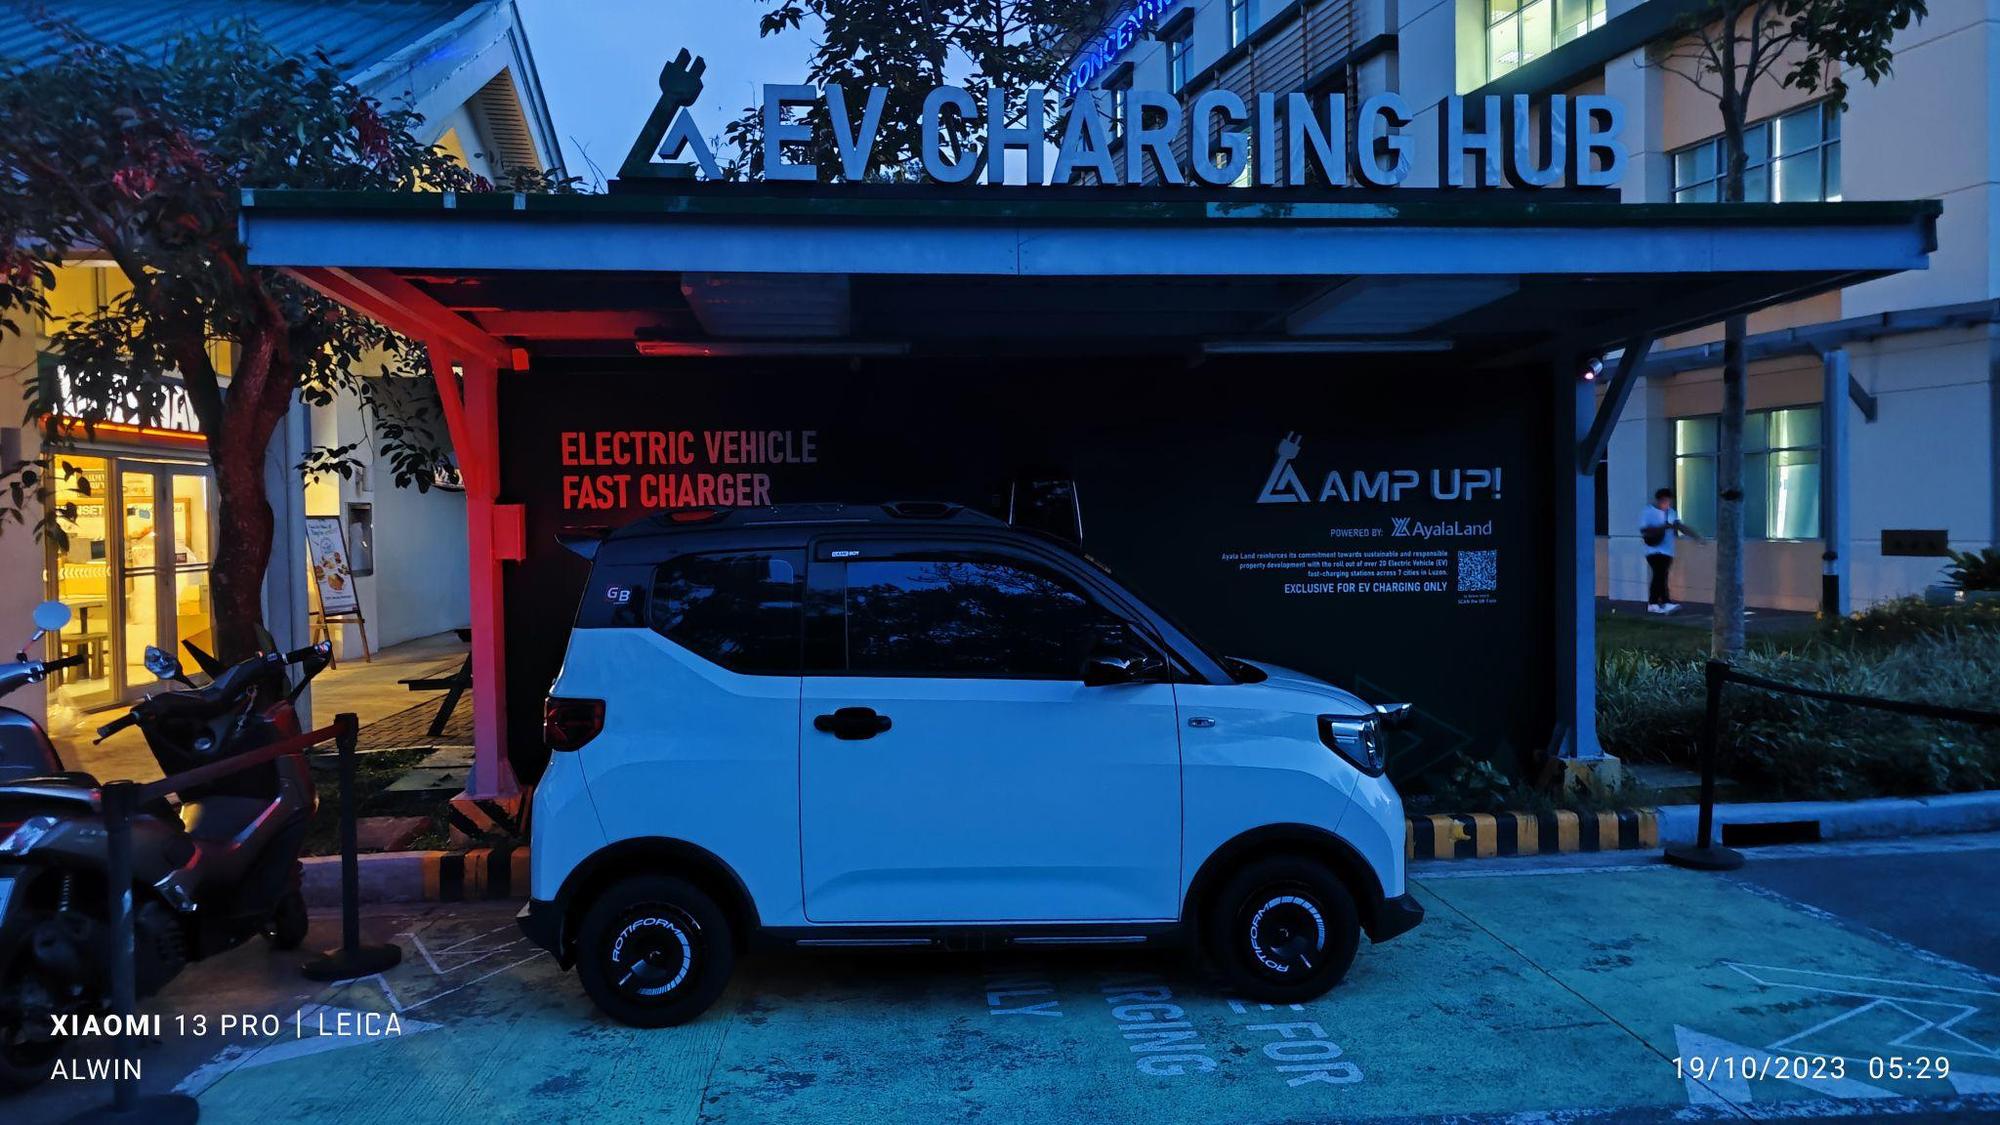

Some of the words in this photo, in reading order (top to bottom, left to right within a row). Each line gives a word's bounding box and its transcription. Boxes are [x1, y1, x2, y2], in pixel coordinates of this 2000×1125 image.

[763, 84, 888, 182] EV
[921, 85, 1414, 188] CHARGING
[1444, 93, 1629, 189] HUB
[562, 431, 695, 466] ELECTRIC
[704, 430, 818, 465] VEHICLE
[563, 474, 632, 510] FAST
[640, 473, 772, 508] CHARGER
[1318, 469, 1421, 503] AMP
[1431, 467, 1503, 502] UP!
[1330, 528, 1370, 538] POWERED
[1371, 528, 1384, 537] BY:
[1411, 520, 1493, 541] AyalaLand
[1239, 562, 1266, 571] property
[1266, 562, 1306, 570] development
[1333, 560, 1345, 568] roll
[1388, 559, 1412, 567] Electric
[1413, 559, 1435, 567] Vehicle
[1240, 552, 1256, 560] Land
[1337, 551, 1362, 559] towards
[1413, 550, 1448, 559] responsible
[1284, 583, 1335, 594] EXCLUSIVE
[1336, 583, 1356, 593] FOR
[1357, 583, 1371, 593] EV
[1372, 582, 1421, 593] CHARGING
[1422, 581, 1448, 592] ONLY
[1307, 570, 1350, 579] fast-charging
[1428, 568, 1449, 576] Luzon.
[612, 917, 682, 963] ROTIFORM
[1250, 903, 1290, 973] ROTIFORM
[1246, 1020, 1365, 1088] FOR
